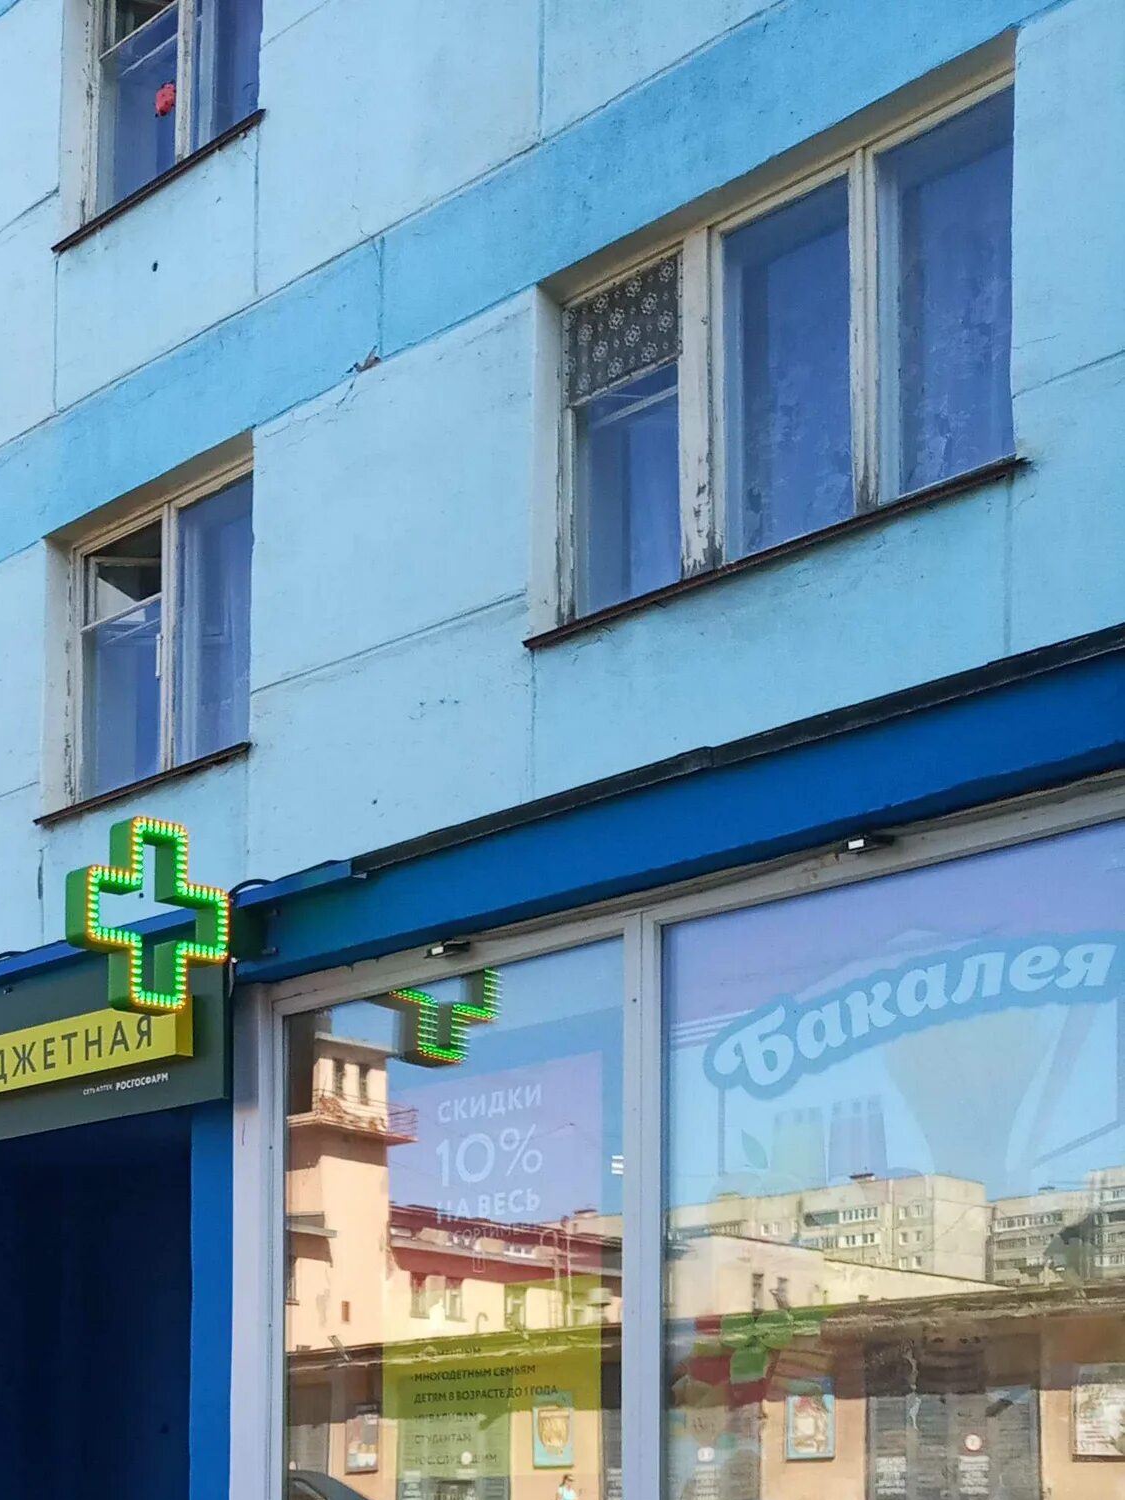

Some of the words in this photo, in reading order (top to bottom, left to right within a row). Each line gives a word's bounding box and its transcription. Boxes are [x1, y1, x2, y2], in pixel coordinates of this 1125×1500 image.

[714, 942, 1117, 1086] Бакалея
[115, 1072, 169, 1091] РОСГОСФАРМ
[437, 1083, 543, 1123] СКИДКИ
[436, 1124, 544, 1187] 10%
[478, 1188, 541, 1216] ВЕСЬ
[414, 1368, 491, 1382] МНОГОДЕТНЫМ
[493, 1365, 536, 1377] СЕМЬЯМ
[414, 1391, 447, 1404] ДЕТЯМ
[457, 1388, 505, 1401] ВОЗРАСТЕ
[506, 1386, 521, 1399] ДО
[530, 1384, 558, 1397] ГОДА
